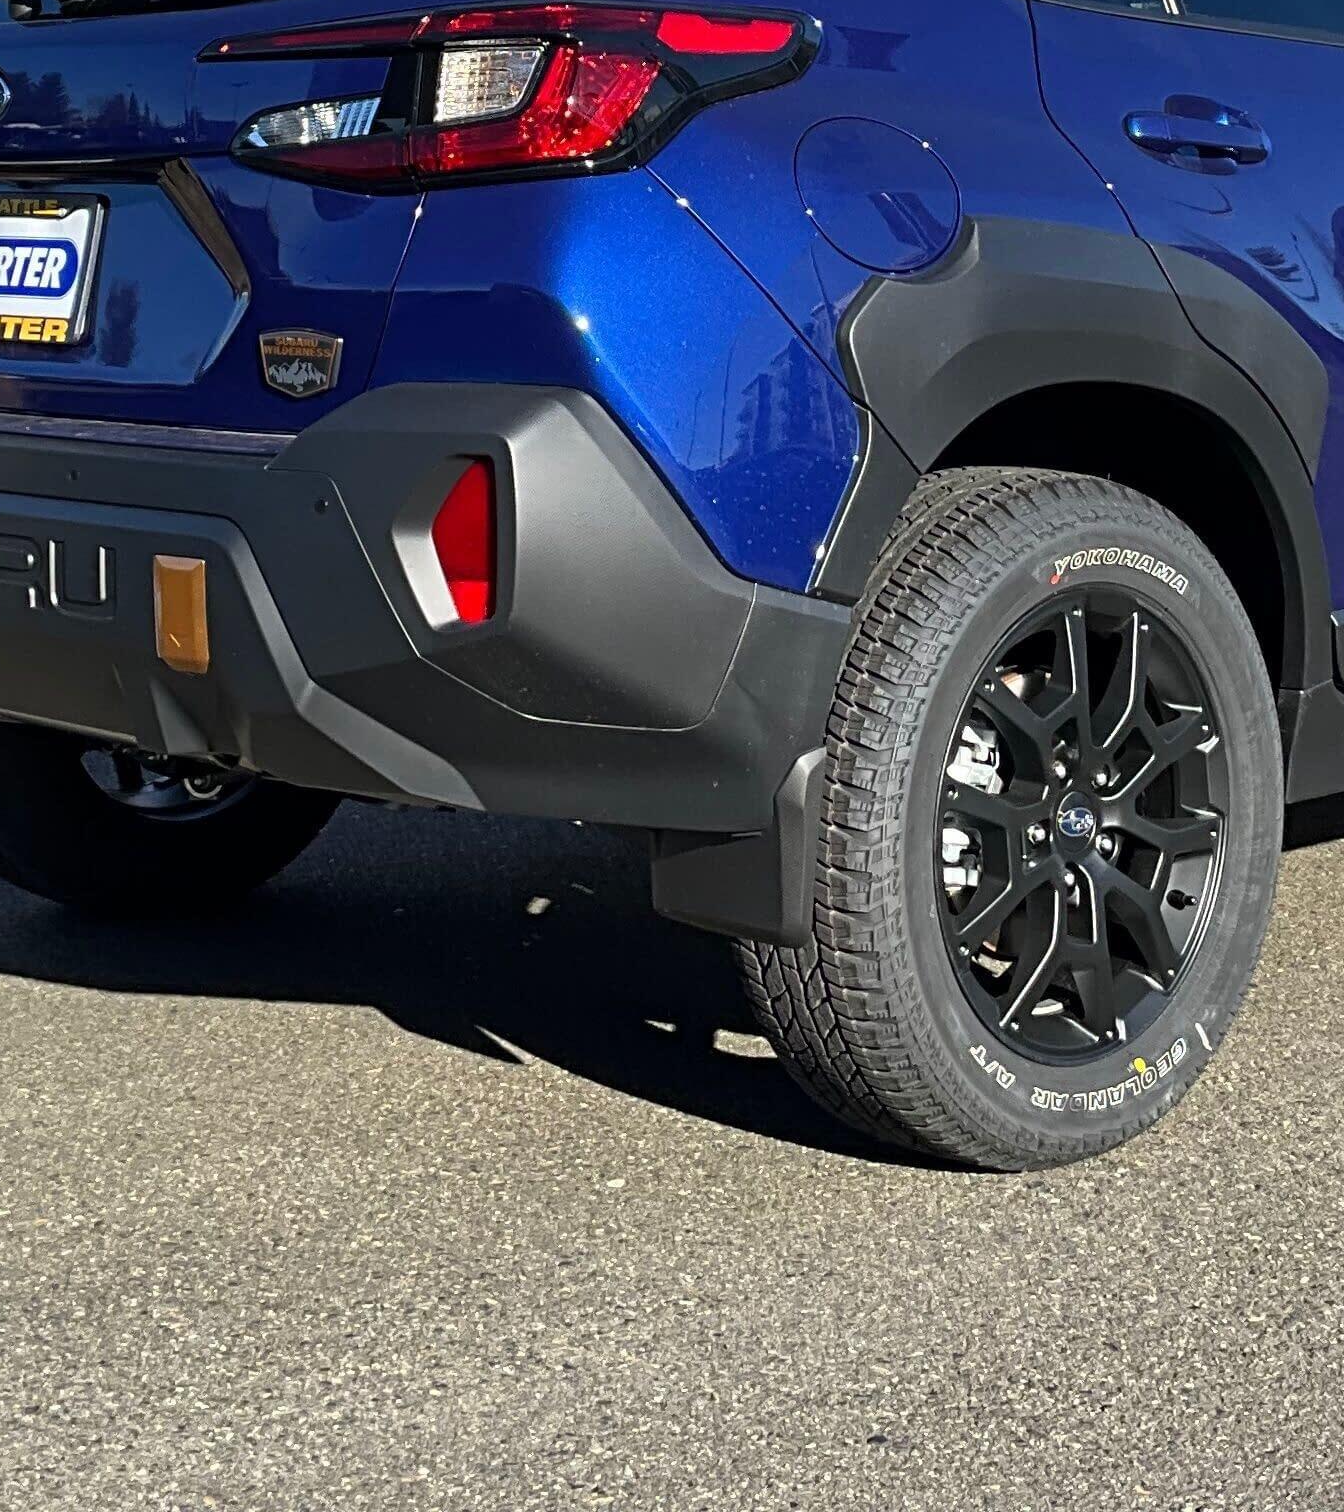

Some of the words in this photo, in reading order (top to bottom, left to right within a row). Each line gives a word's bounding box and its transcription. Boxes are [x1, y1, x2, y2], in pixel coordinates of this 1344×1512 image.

[263, 345, 333, 358] WILDERNESS
[274, 336, 319, 348] SUBARU
[1054, 547, 1190, 595] YOKOHAMA
[968, 1043, 1017, 1089] A/T
[1030, 1037, 1188, 1112] GEOLANDAR
